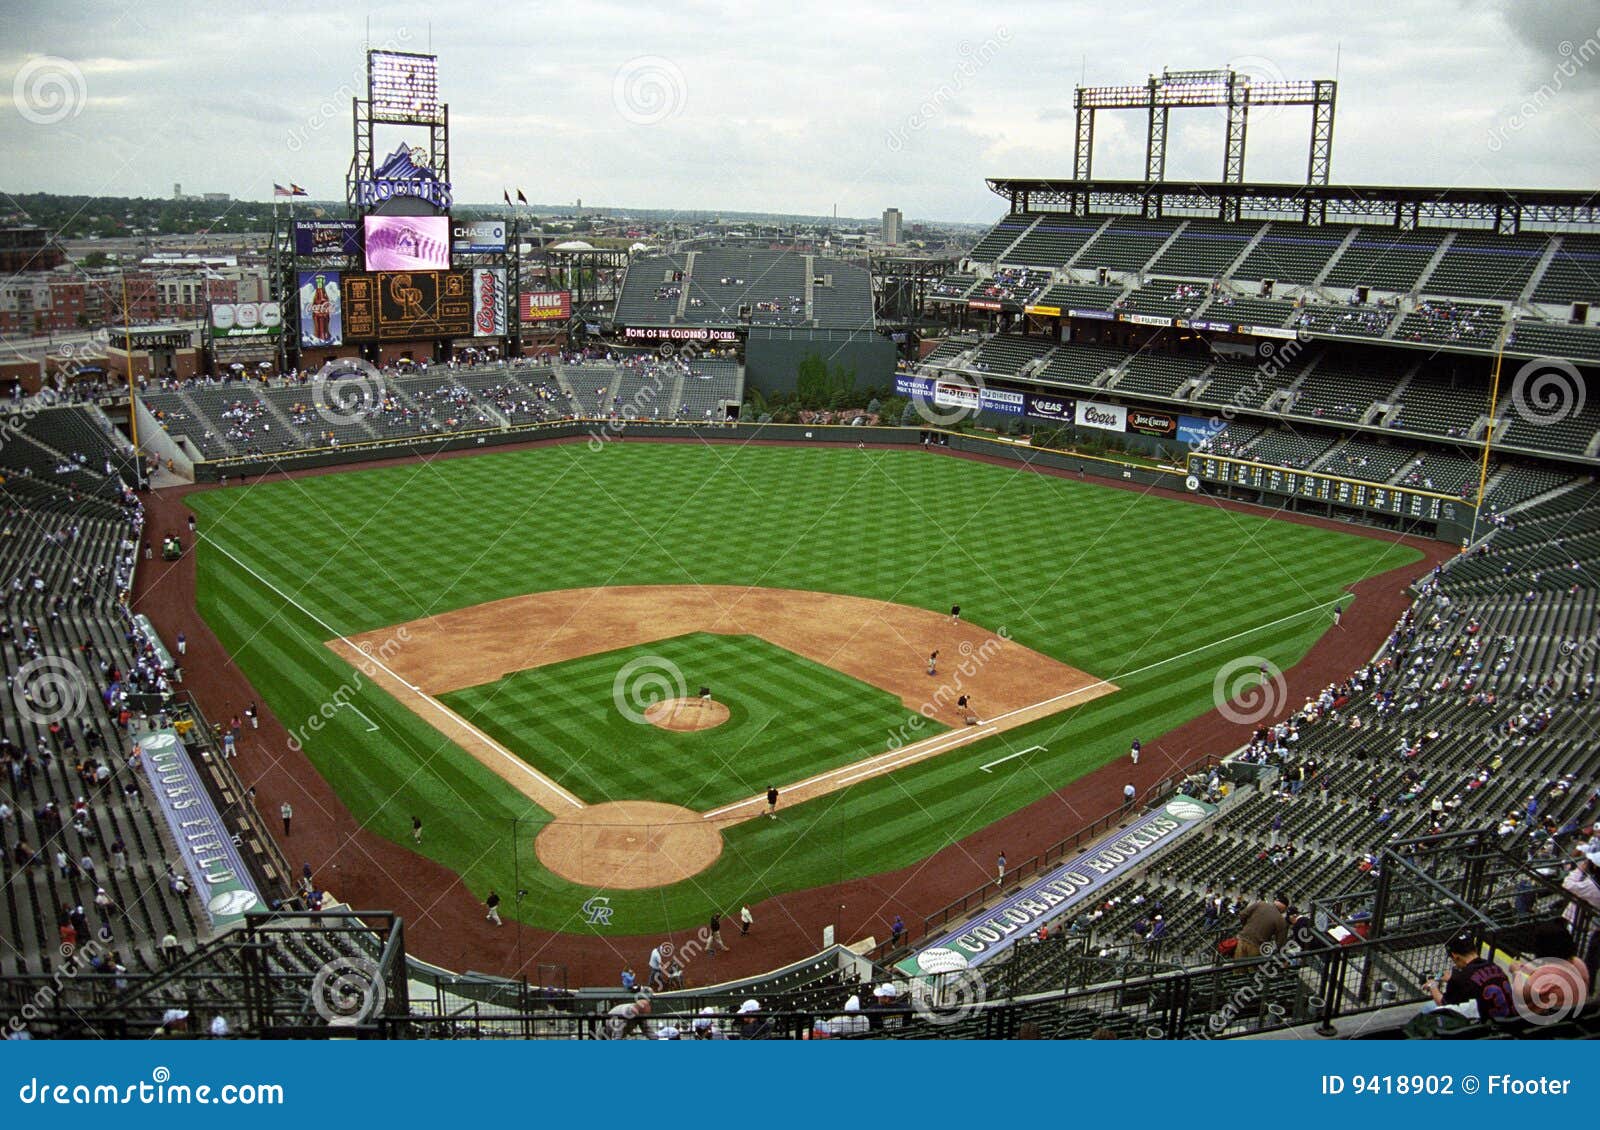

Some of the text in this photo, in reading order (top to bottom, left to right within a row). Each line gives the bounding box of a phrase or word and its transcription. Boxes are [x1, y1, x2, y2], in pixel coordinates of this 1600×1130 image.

[356, 179, 453, 208] ROCKIES
[454, 227, 492, 237] CHASE
[477, 272, 494, 333] Coors
[494, 274, 506, 334] LIGHT
[529, 294, 562, 307] KING
[529, 306, 562, 318] Soopers
[1141, 316, 1170, 326] FUJIFILM
[626, 327, 735, 339] HOME OF THE COLORADO ROCKIES
[992, 391, 1021, 403] DIRECTV
[1084, 406, 1117, 427] Coors
[1134, 413, 1169, 428] Jose Cuervo
[152, 752, 201, 810] COORS
[181, 816, 237, 884] FIELD
[956, 815, 1179, 953] COLORADO ROCKIES
